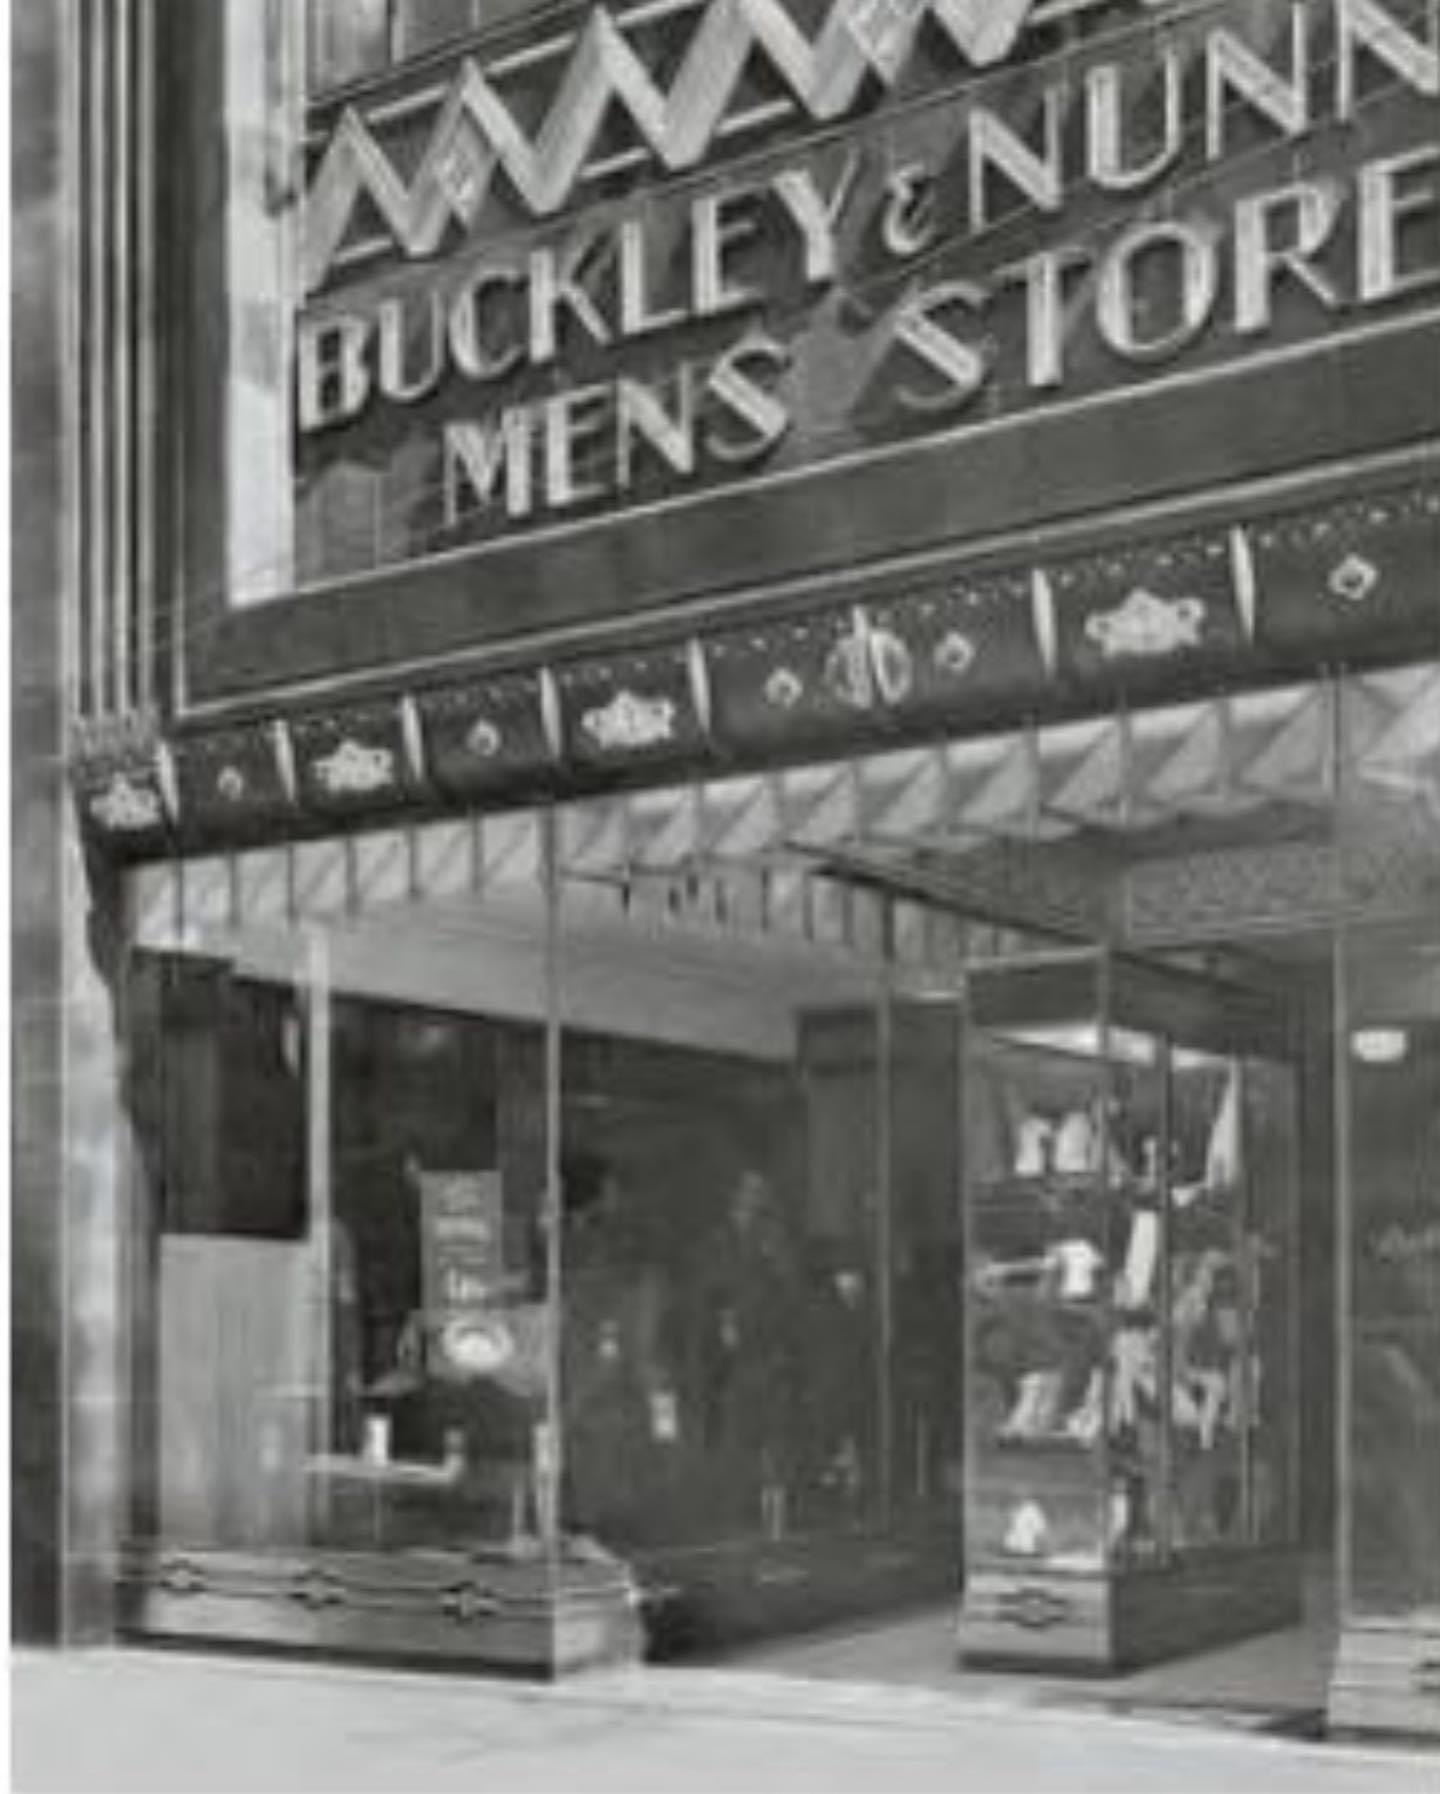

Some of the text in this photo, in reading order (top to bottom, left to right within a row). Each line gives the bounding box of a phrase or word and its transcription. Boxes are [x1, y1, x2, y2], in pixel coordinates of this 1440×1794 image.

[298, 0, 1440, 430] BUCKLEY & NUNN
[443, 145, 1440, 526] MENS STORE
